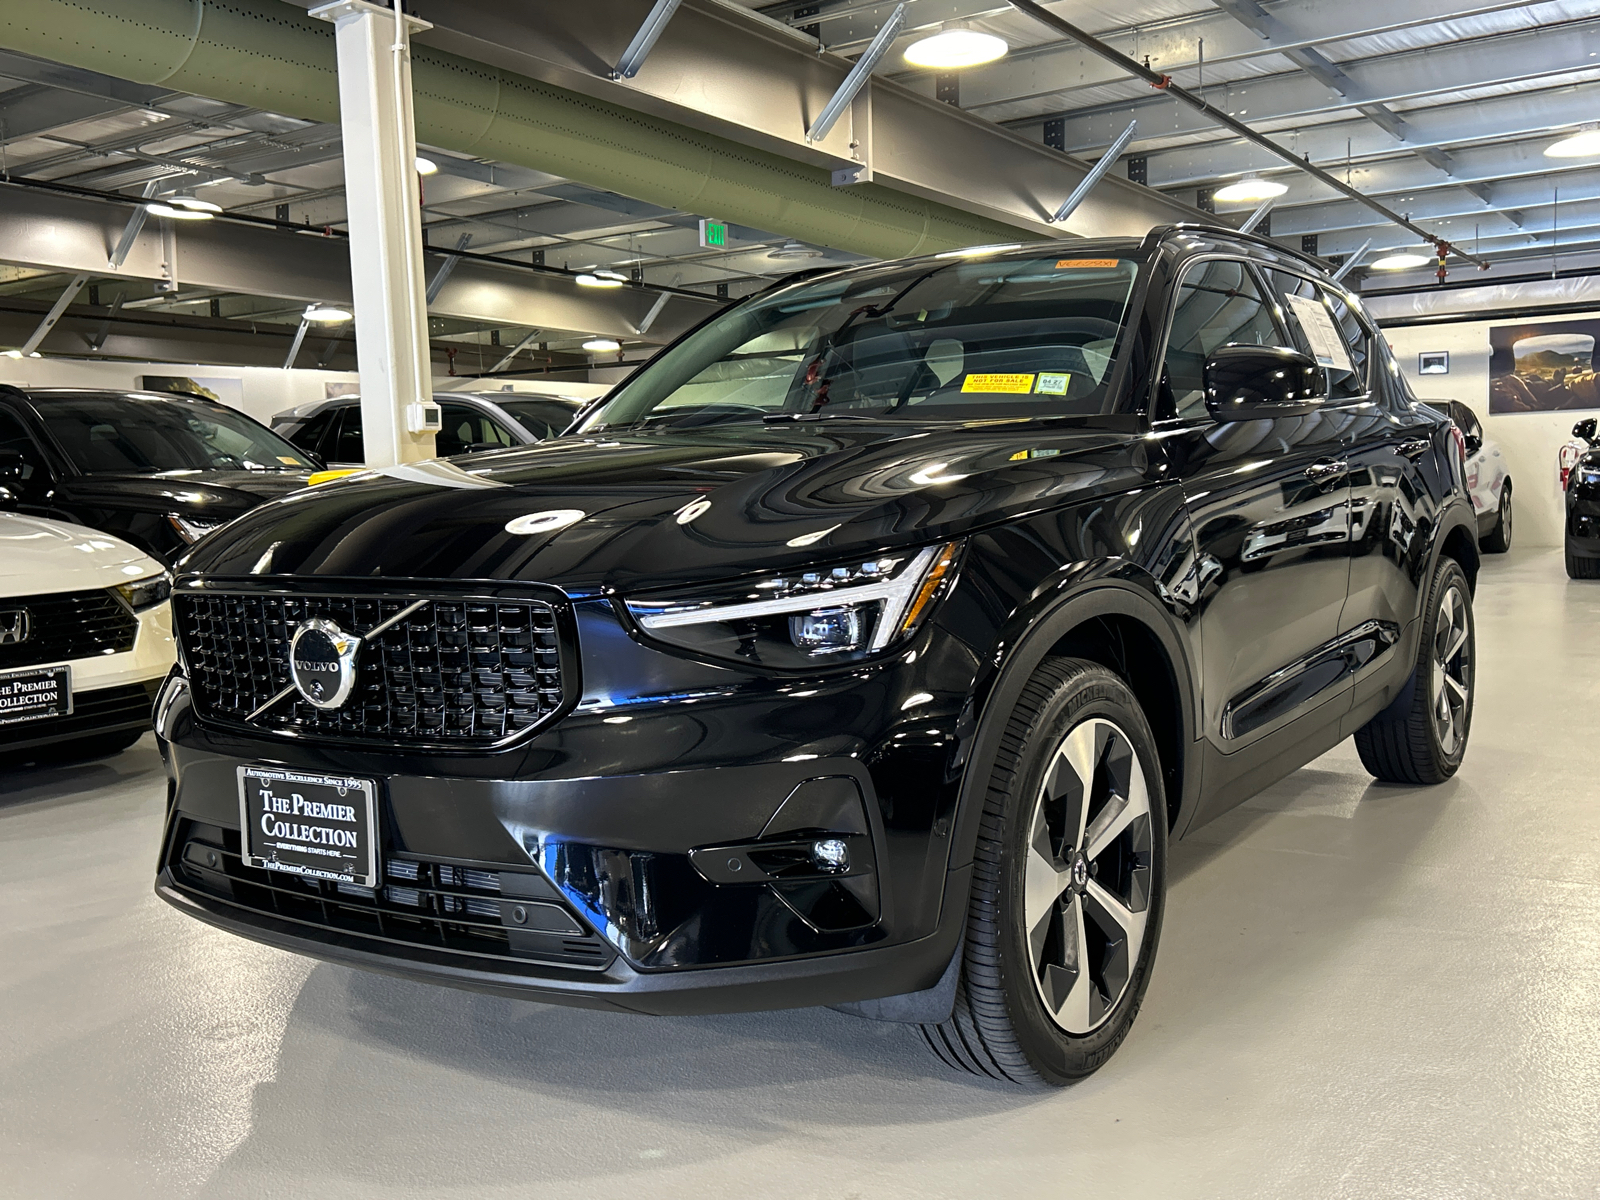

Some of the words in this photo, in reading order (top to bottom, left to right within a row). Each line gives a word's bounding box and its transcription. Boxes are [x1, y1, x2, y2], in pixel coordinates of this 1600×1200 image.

[708, 223, 725, 246] EXIT
[295, 660, 340, 673] VOLVO
[0, 686, 12, 696] HE
[13, 680, 58, 694] PREMIER
[0, 691, 58, 708] OLLECTION
[246, 768, 285, 780] AUTOMOTIVE
[285, 772, 324, 784] EXCELLENCE
[323, 777, 343, 787] SINCE
[343, 779, 362, 789] 1995
[259, 790, 291, 814] THE
[291, 793, 357, 823] PREMIER
[261, 813, 358, 848] COLLECTION
[276, 842, 307, 853] EVERYTHING
[307, 847, 326, 856] STARTS
